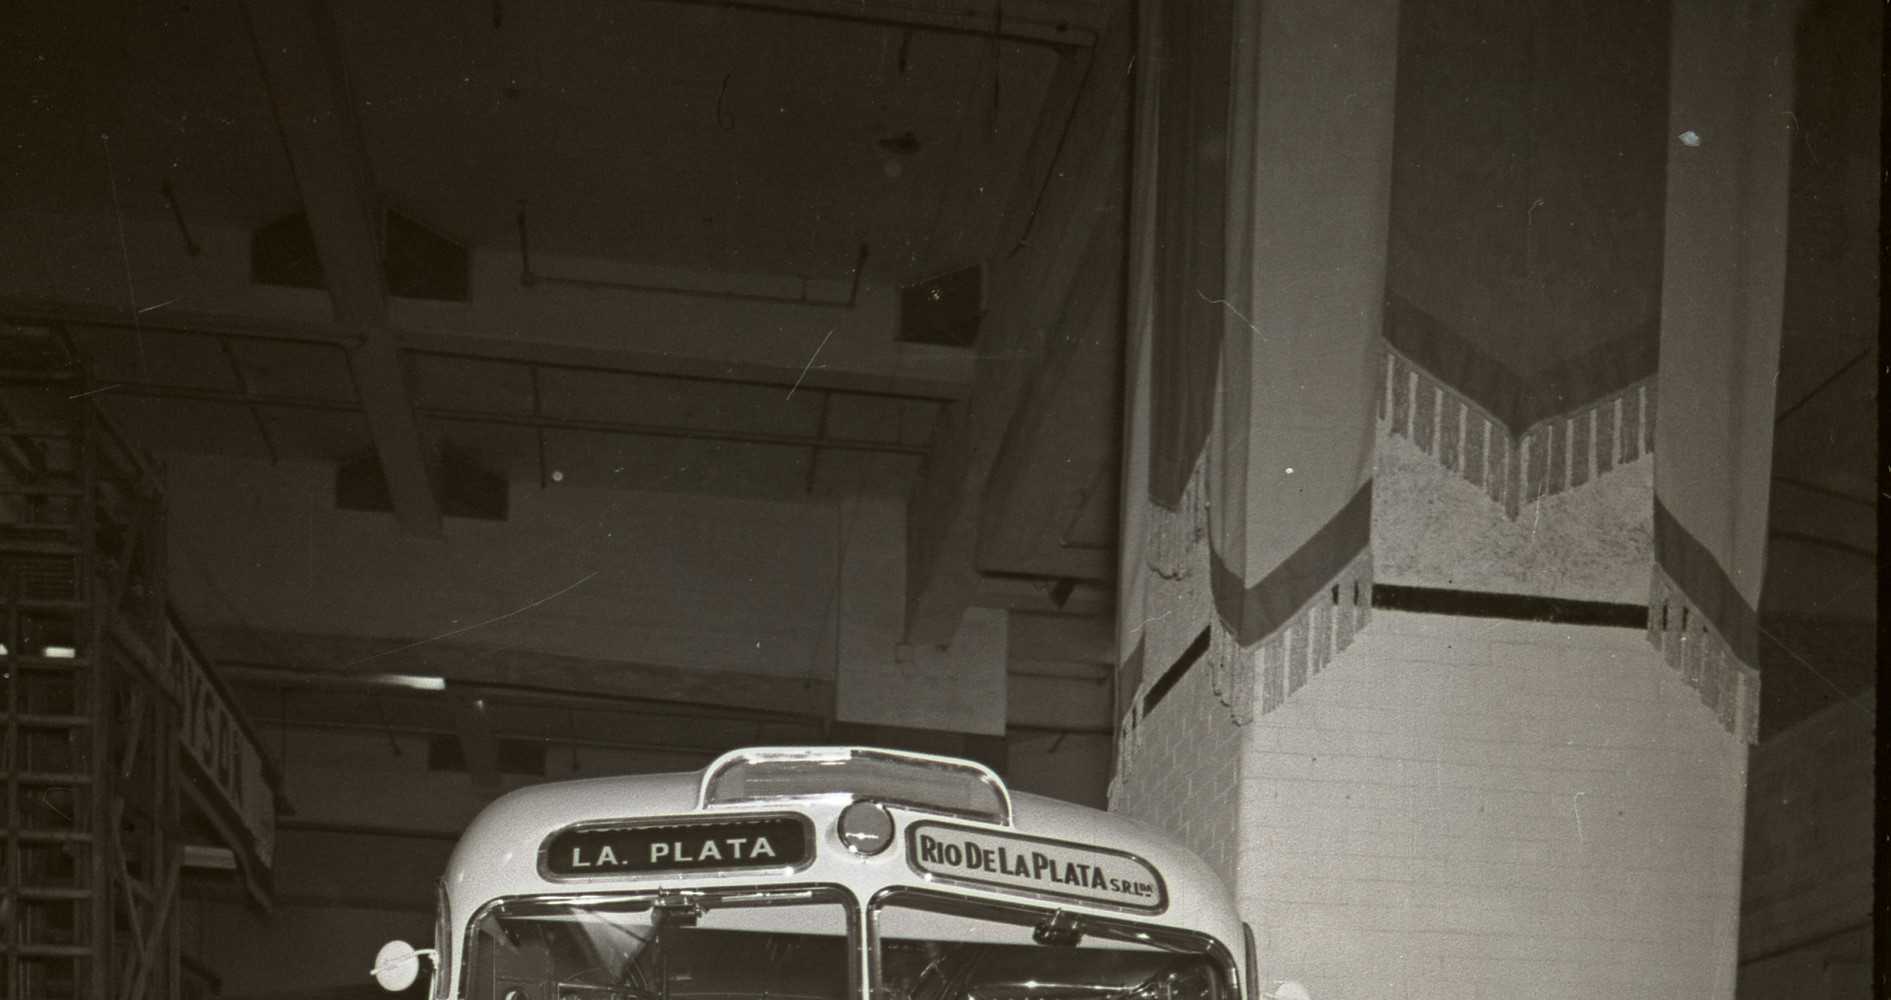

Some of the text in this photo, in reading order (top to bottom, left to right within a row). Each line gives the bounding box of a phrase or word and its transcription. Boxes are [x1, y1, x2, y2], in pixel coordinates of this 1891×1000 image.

[571, 836, 776, 867] LA. PLATA
[919, 834, 963, 867] RIO
[1031, 852, 1107, 891] PLATA
